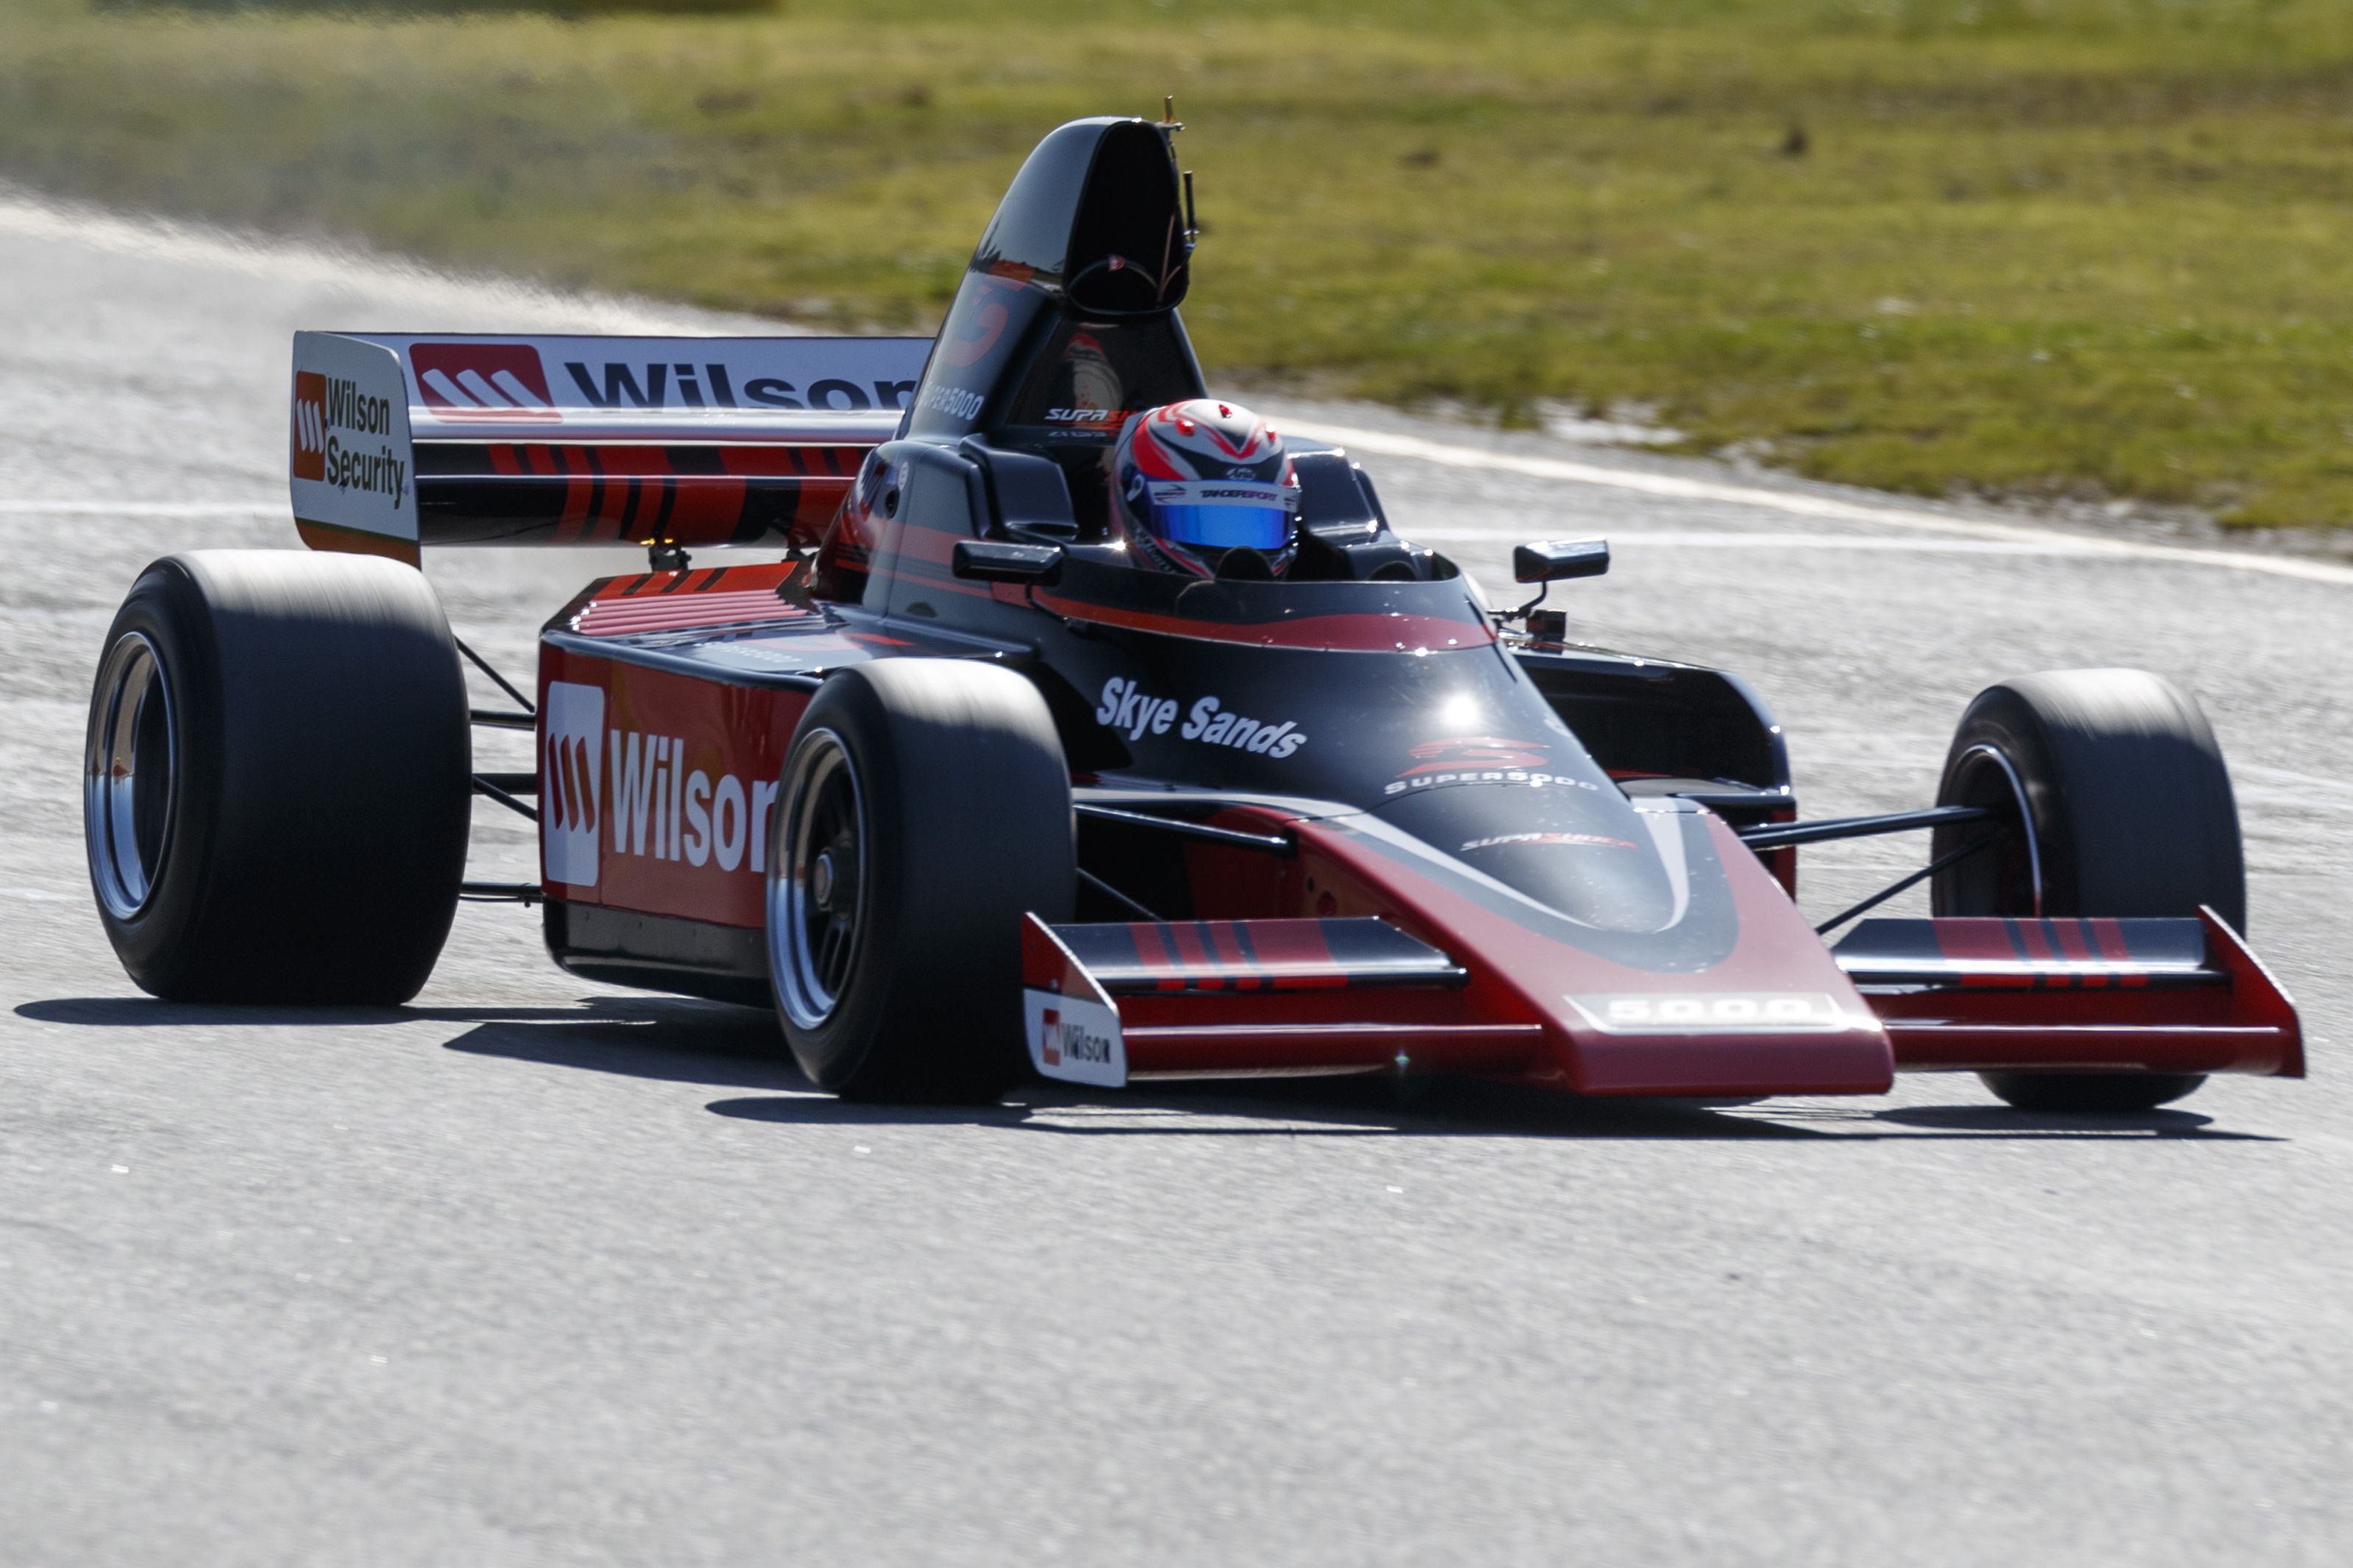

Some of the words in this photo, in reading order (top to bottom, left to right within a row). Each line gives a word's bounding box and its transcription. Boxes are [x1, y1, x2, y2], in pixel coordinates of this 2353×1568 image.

[328, 378, 390, 435] Wilson
[327, 435, 405, 510] Security
[1096, 676, 1179, 741] Skye
[1182, 696, 1307, 759] Sands
[1608, 998, 1813, 1020] 5000
[1062, 1023, 1111, 1064] Wilson
